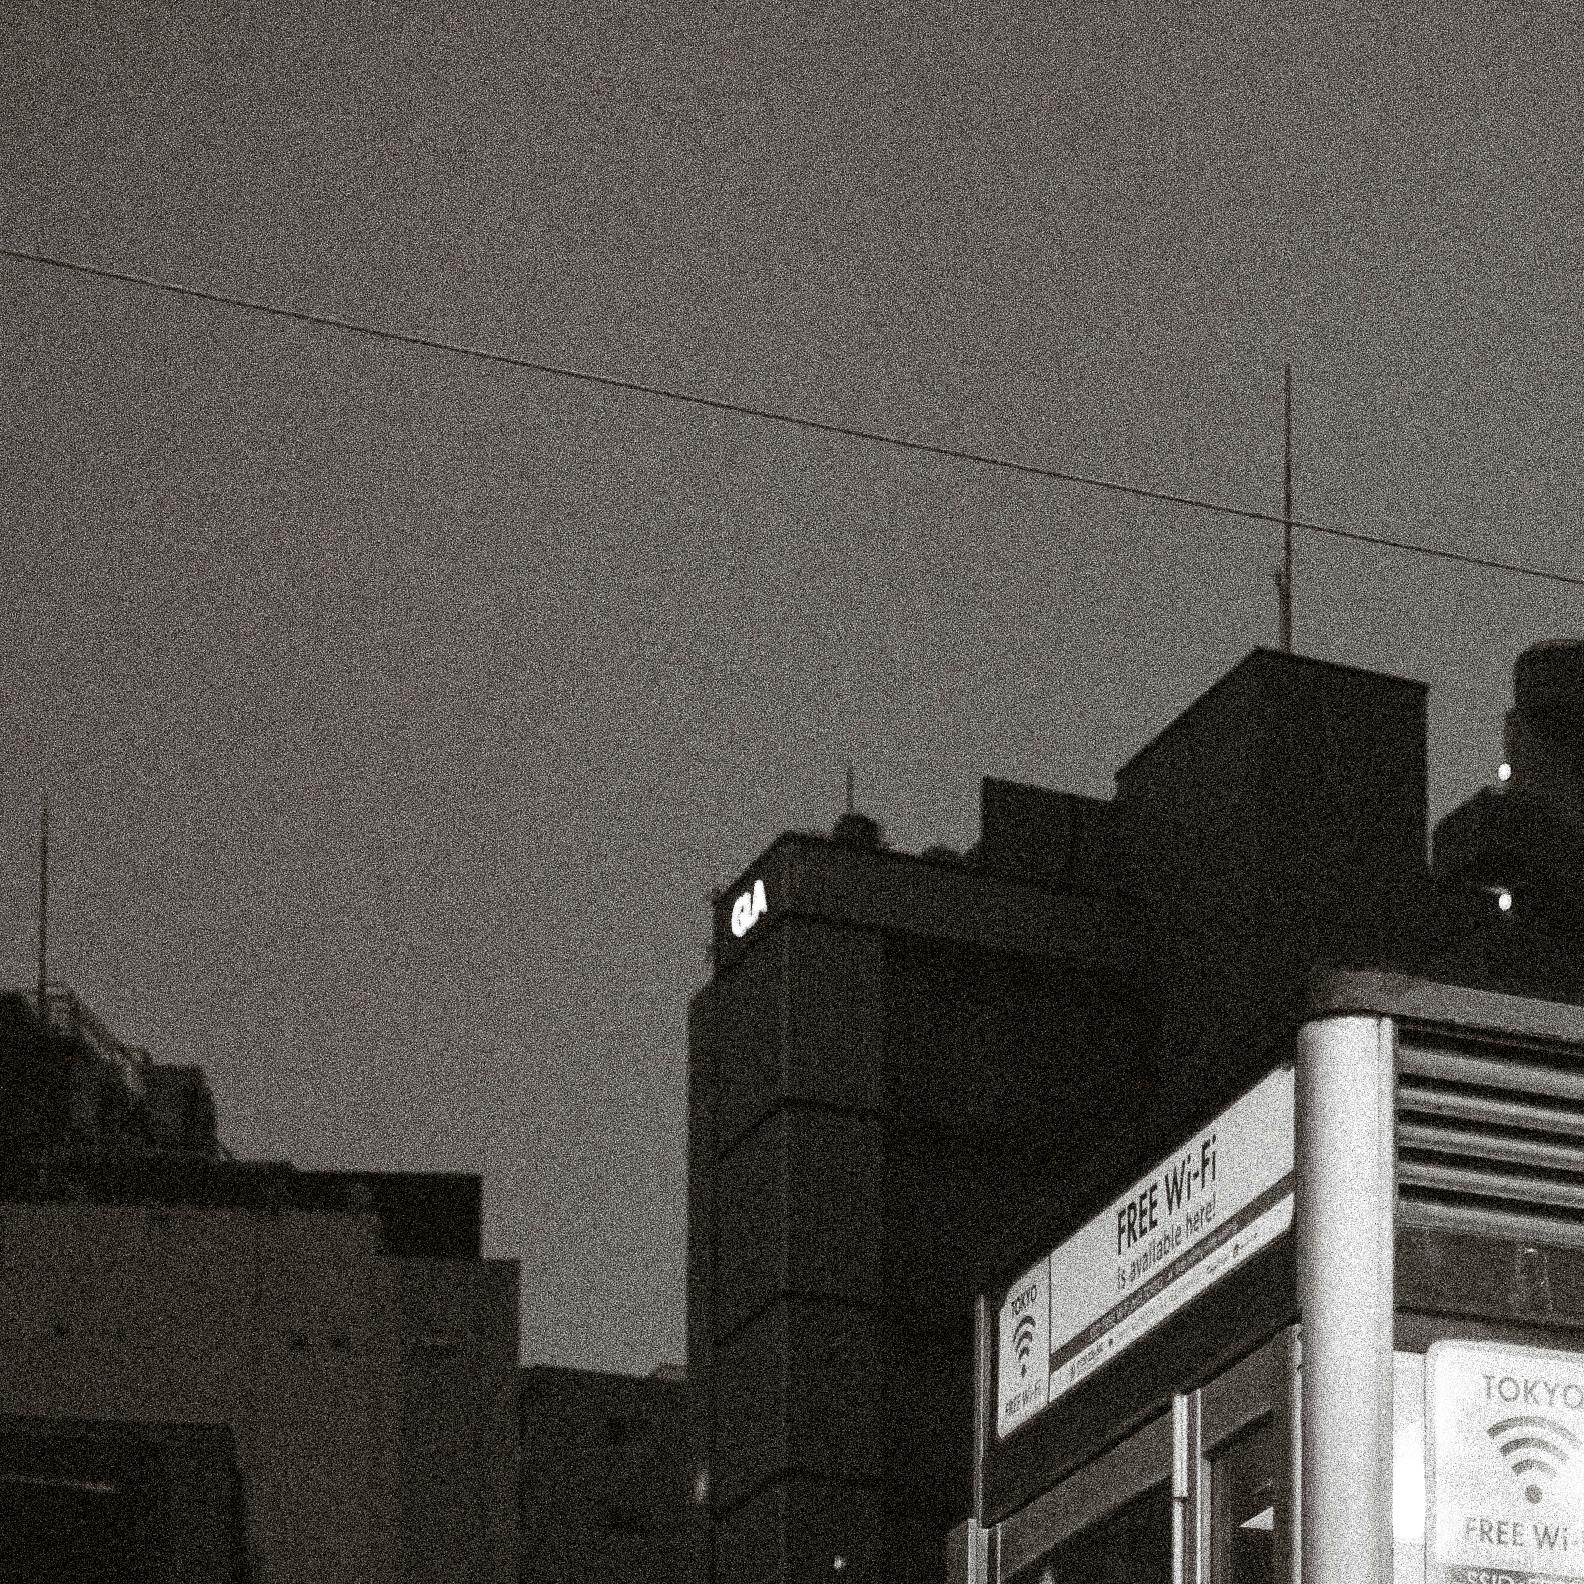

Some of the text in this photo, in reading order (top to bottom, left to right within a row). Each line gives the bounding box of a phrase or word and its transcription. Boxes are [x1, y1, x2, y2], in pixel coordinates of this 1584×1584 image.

[1116, 1183, 1159, 1255] FREE
[1164, 1133, 1218, 1216] Wi-Fi
[1128, 1222, 1184, 1280] available
[1463, 1517, 1525, 1548] FREE
